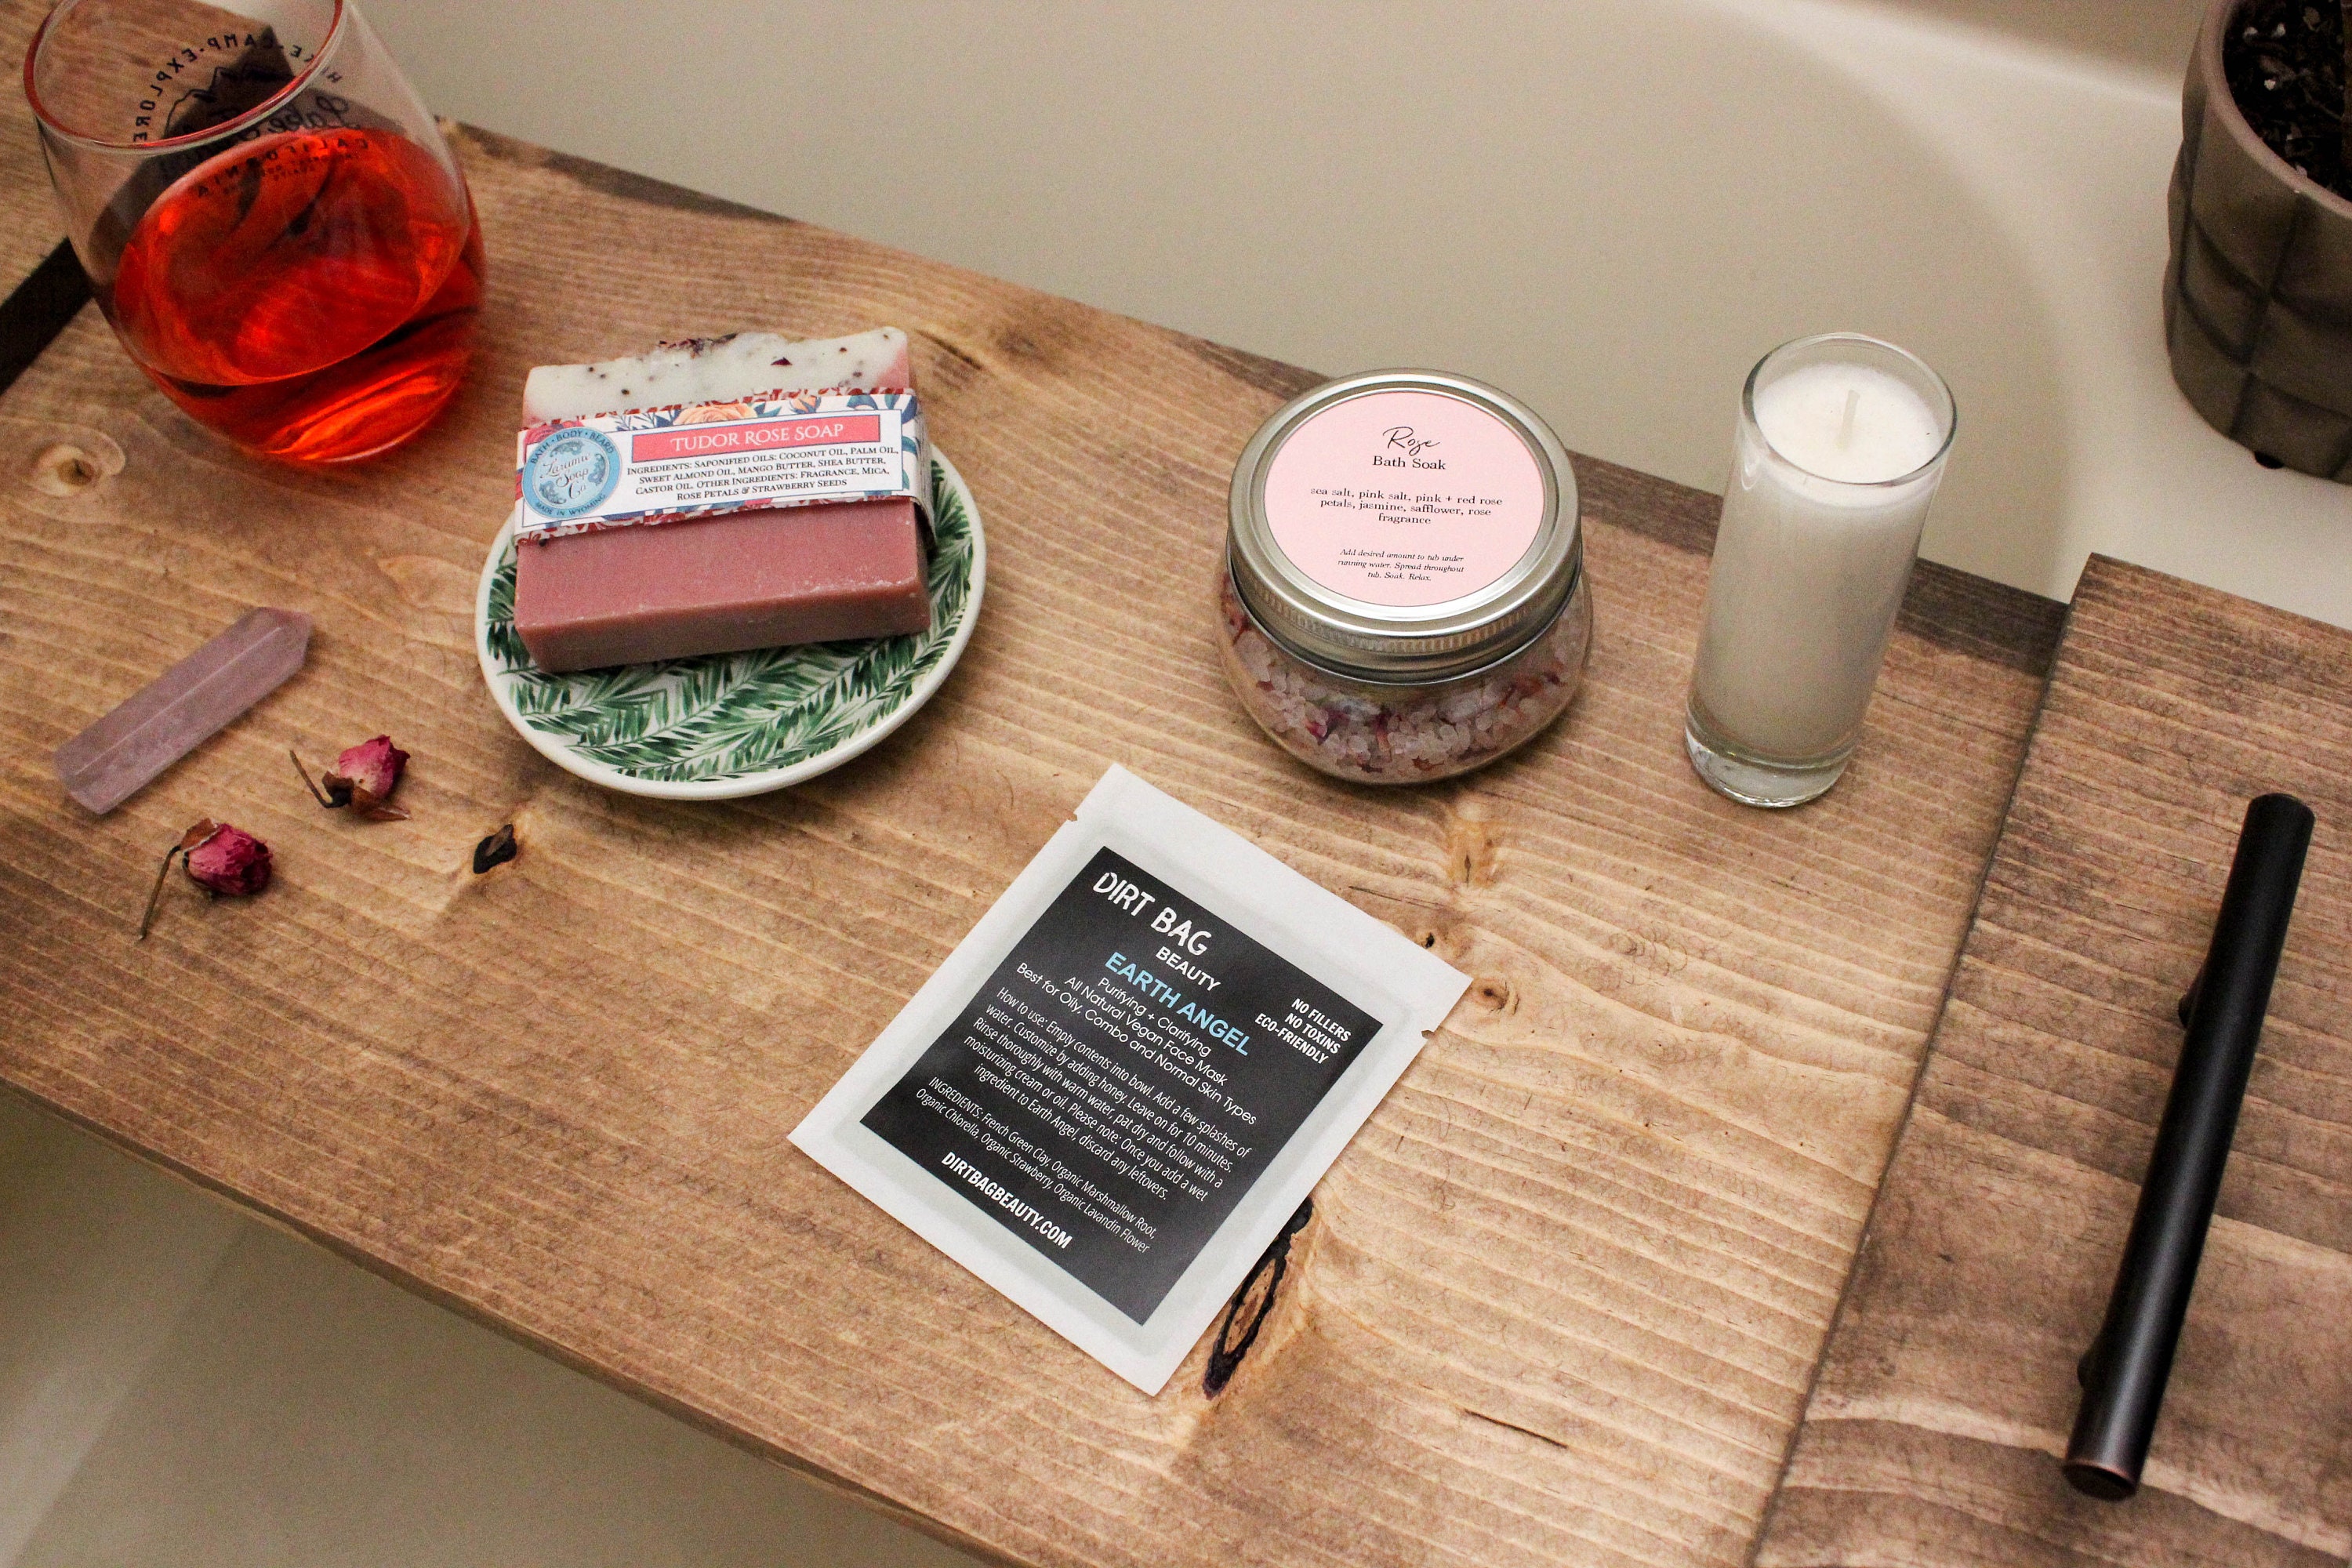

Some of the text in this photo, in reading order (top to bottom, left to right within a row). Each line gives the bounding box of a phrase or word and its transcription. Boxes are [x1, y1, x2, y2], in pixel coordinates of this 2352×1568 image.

[531, 430, 614, 464] BATH BODY BEARD
[670, 423, 844, 452] TUDOR ROSE SOAP
[1372, 456, 1446, 470] Bath Soak
[1382, 426, 1440, 456] Rose
[1320, 499, 1356, 510] petals,
[1358, 500, 1406, 512] jasmine,
[1410, 504, 1464, 516] safflower,
[1331, 488, 1355, 498] salt,
[1359, 489, 1385, 499] pink
[1388, 492, 1411, 502] salt,
[1416, 493, 1442, 503] pink
[1457, 495, 1475, 504] red
[1378, 513, 1431, 524] fragrance
[1338, 560, 1367, 568] running
[1394, 562, 1421, 571] Spread
[1424, 564, 1465, 573] throughout
[1093, 872, 1212, 956] DIRT BAG
[1105, 952, 1250, 1056] EARTH ANGEL
[1155, 946, 1221, 991] BEAUTY
[1016, 962, 1257, 1125] Best for Oily, Combo and Normal Skin Types
[1064, 977, 1228, 1086] All Natural Vegan Face Mask
[1098, 977, 1212, 1058] Purifying Clarifying
[1254, 1013, 1329, 1064] ECO-FRIENDLY
[1284, 1013, 1341, 1054] NO TOXINS
[1291, 998, 1352, 1042] NO FILLERS
[973, 1017, 1215, 1183] Rinse thoroughly with warm water, pat dry and follow with
[986, 1004, 1233, 1173] water. Customize by adding honey. Leave on for 10 minutes.
[996, 987, 1252, 1158] How to use: Empty contents into bowl. Add few splashes of
[928, 1076, 1156, 1240] INGREDIENTS: French Green Clay, Organic Marshmallow Root,
[964, 1036, 1208, 1202] moisturizing cream or oil. Please note: Once you add wet
[974, 1063, 1168, 1200] ingredient to Earth Angel, discard any leftovers.
[916, 1088, 1150, 1253] Organic Chlorella, Organic Strawberry, Organic Lavandin Flower
[941, 1152, 1073, 1249] DIRTBAGBEAUTY.COM
